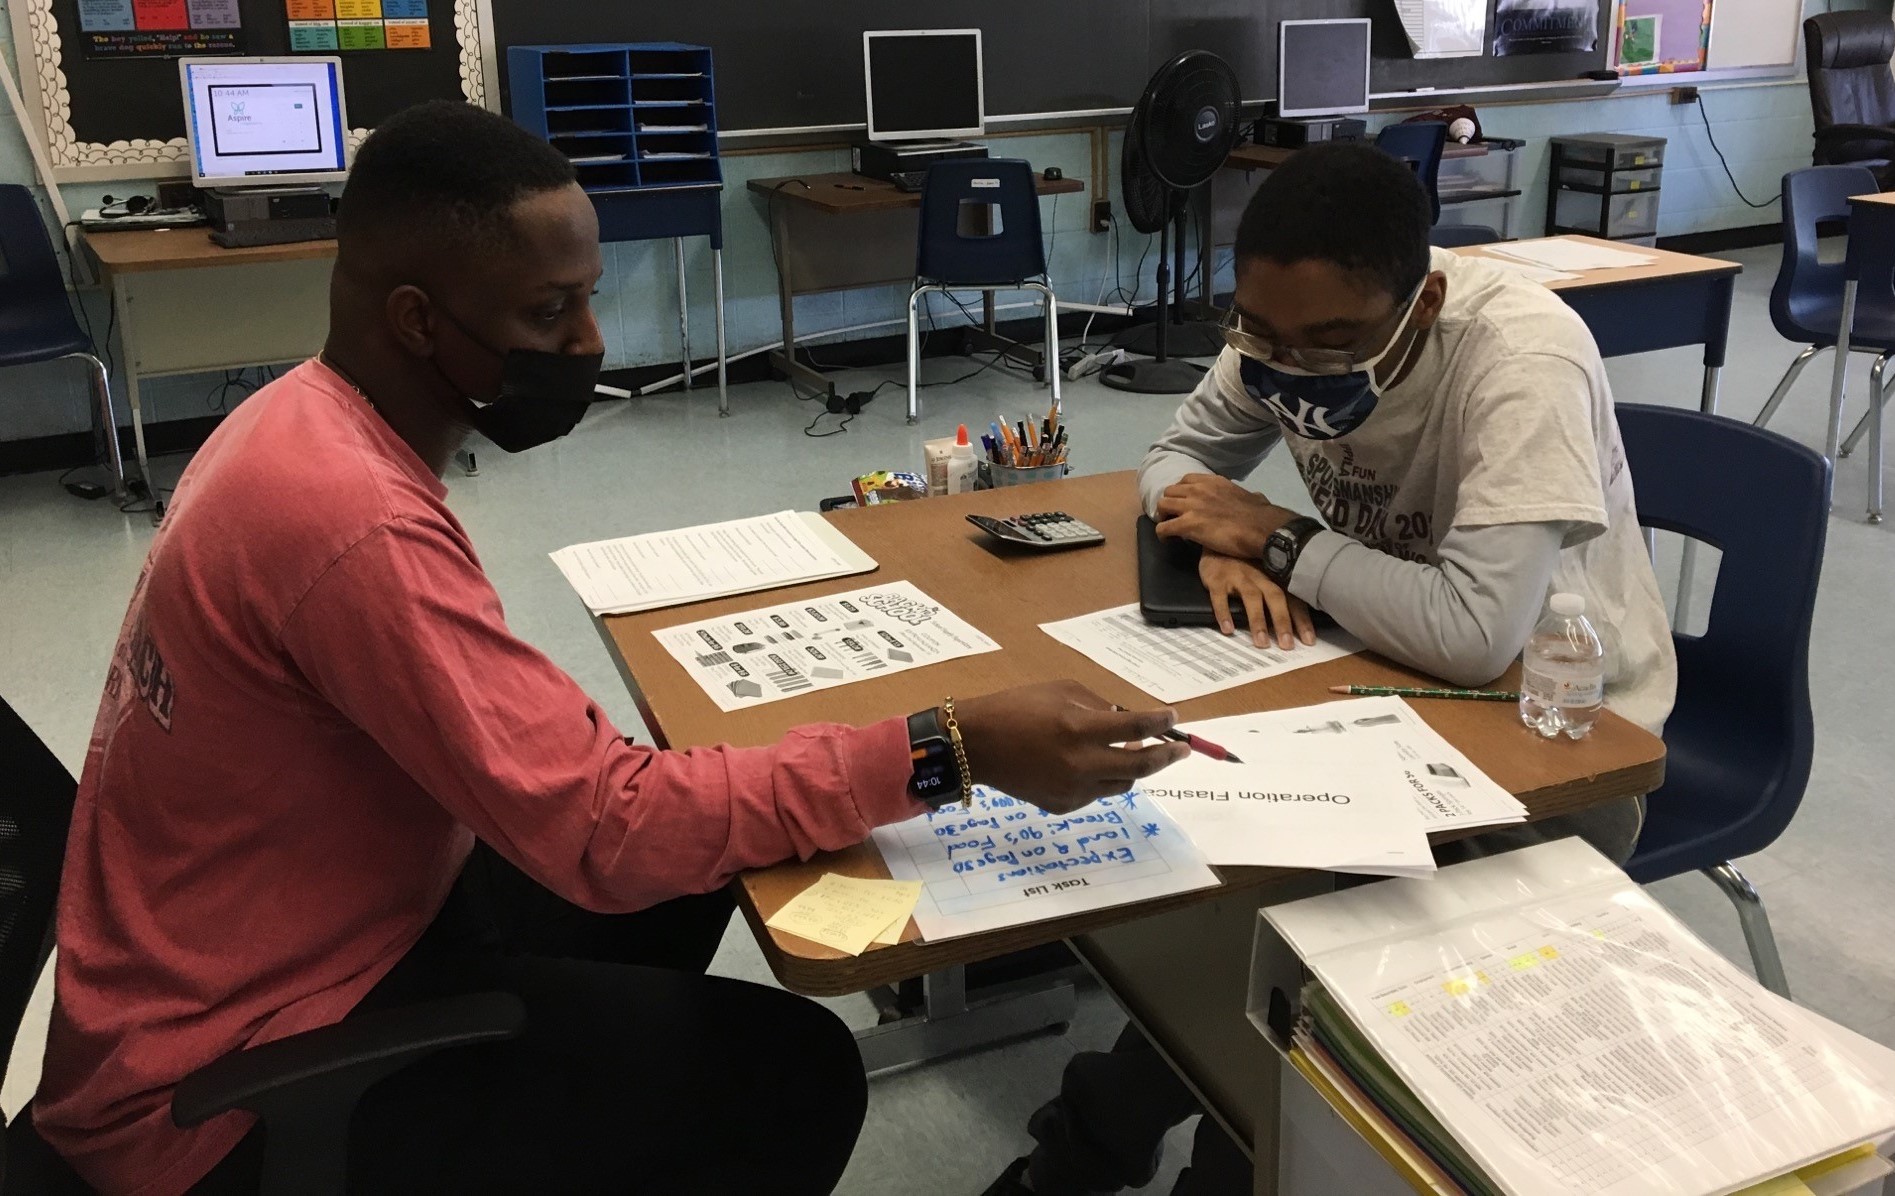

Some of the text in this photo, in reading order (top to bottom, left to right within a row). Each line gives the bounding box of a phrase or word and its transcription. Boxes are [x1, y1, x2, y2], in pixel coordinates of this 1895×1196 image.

[1501, 16, 1589, 36] COMMITMEN
[93, 35, 109, 43] The
[227, 114, 252, 123] Aspire
[1352, 466, 1376, 481] FUN
[916, 776, 942, 790] 10:44
[1143, 788, 1351, 804] Operation Flashca
[1004, 812, 1027, 821] on
[934, 824, 961, 837] 30
[947, 810, 1124, 860] Break: 90's Food
[1076, 831, 1119, 854] and
[1021, 846, 1046, 857] on
[952, 860, 975, 873] 30
[998, 847, 1136, 883] Expectations
[1023, 877, 1090, 898] Task List
